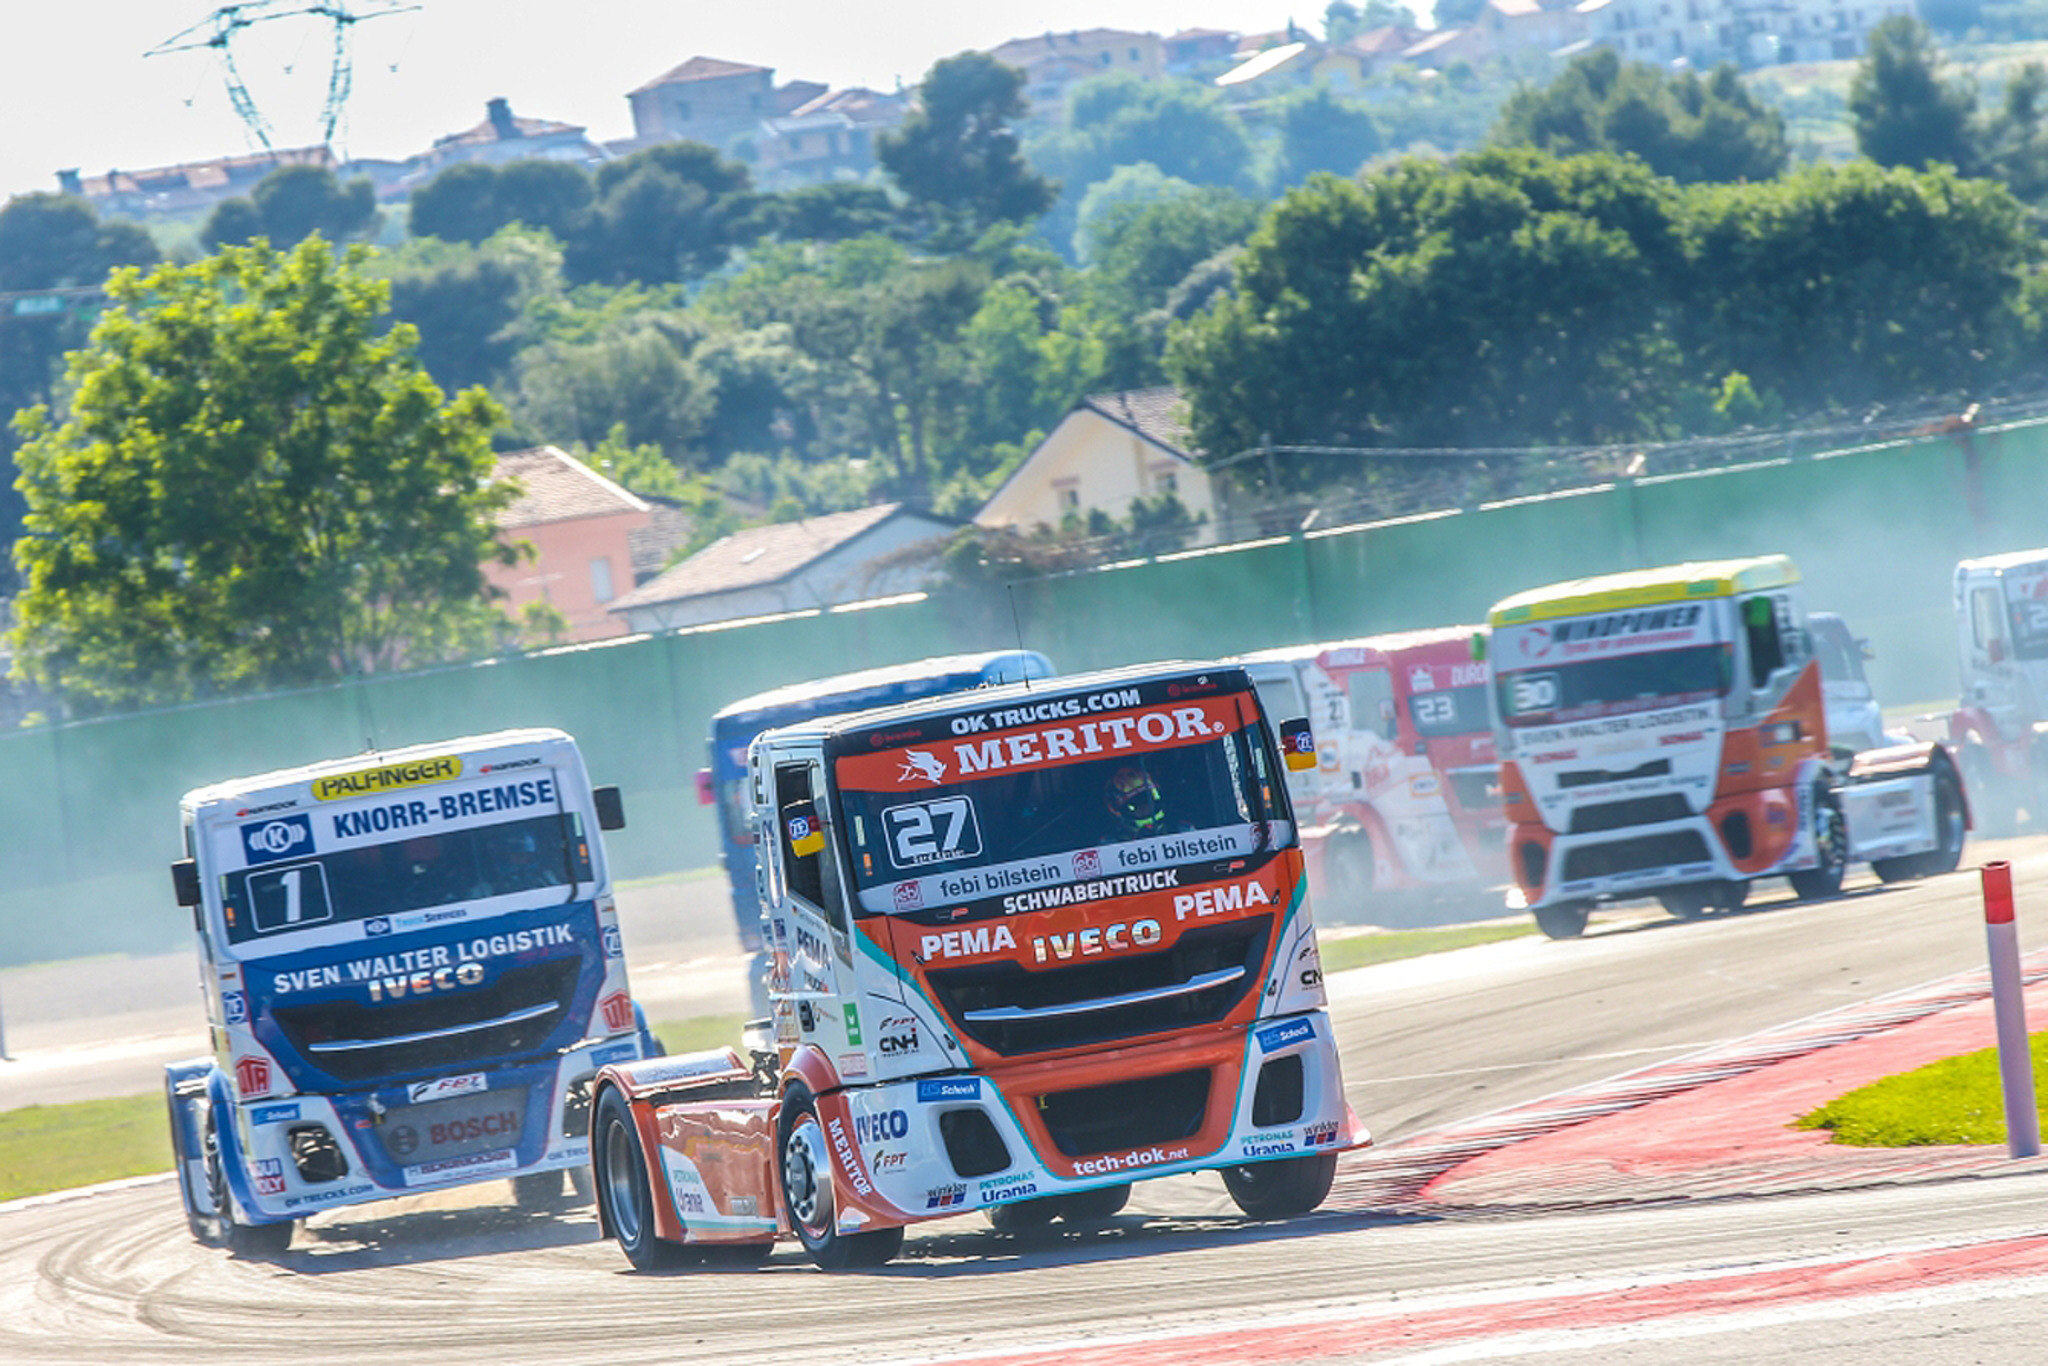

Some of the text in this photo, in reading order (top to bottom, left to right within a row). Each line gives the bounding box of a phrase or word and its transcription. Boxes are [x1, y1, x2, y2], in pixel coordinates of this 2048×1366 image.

[951, 689, 1142, 736] OK TRUCKS.COM
[1416, 694, 1456, 724] 23
[1515, 680, 1556, 710] 30
[953, 706, 1213, 775] MERITOR
[321, 759, 453, 797] PALFINGER
[332, 779, 555, 839] KNORR-BREMSE
[891, 799, 968, 859] 27
[1118, 834, 1237, 867] febi bilstein
[280, 870, 301, 923] 1
[940, 862, 1061, 898] febi bilstein
[1003, 869, 1179, 915] SCHWABENTRUCK
[1174, 880, 1270, 921] PEMA
[273, 923, 574, 994] SVEN WALTER LOGISTIK
[921, 925, 1017, 961] PEMA
[1033, 918, 1162, 964] IVECO
[368, 962, 485, 1002] IVECO
[879, 1027, 919, 1053] CNH
[429, 1111, 518, 1146] BOSCH
[855, 1108, 909, 1144] IVECO
[827, 1116, 873, 1199] MERITOR
[883, 1151, 909, 1168] FPT
[1243, 1141, 1295, 1157] Urania
[979, 1169, 1036, 1191] PETRONAS
[982, 1182, 1038, 1204] Urania
